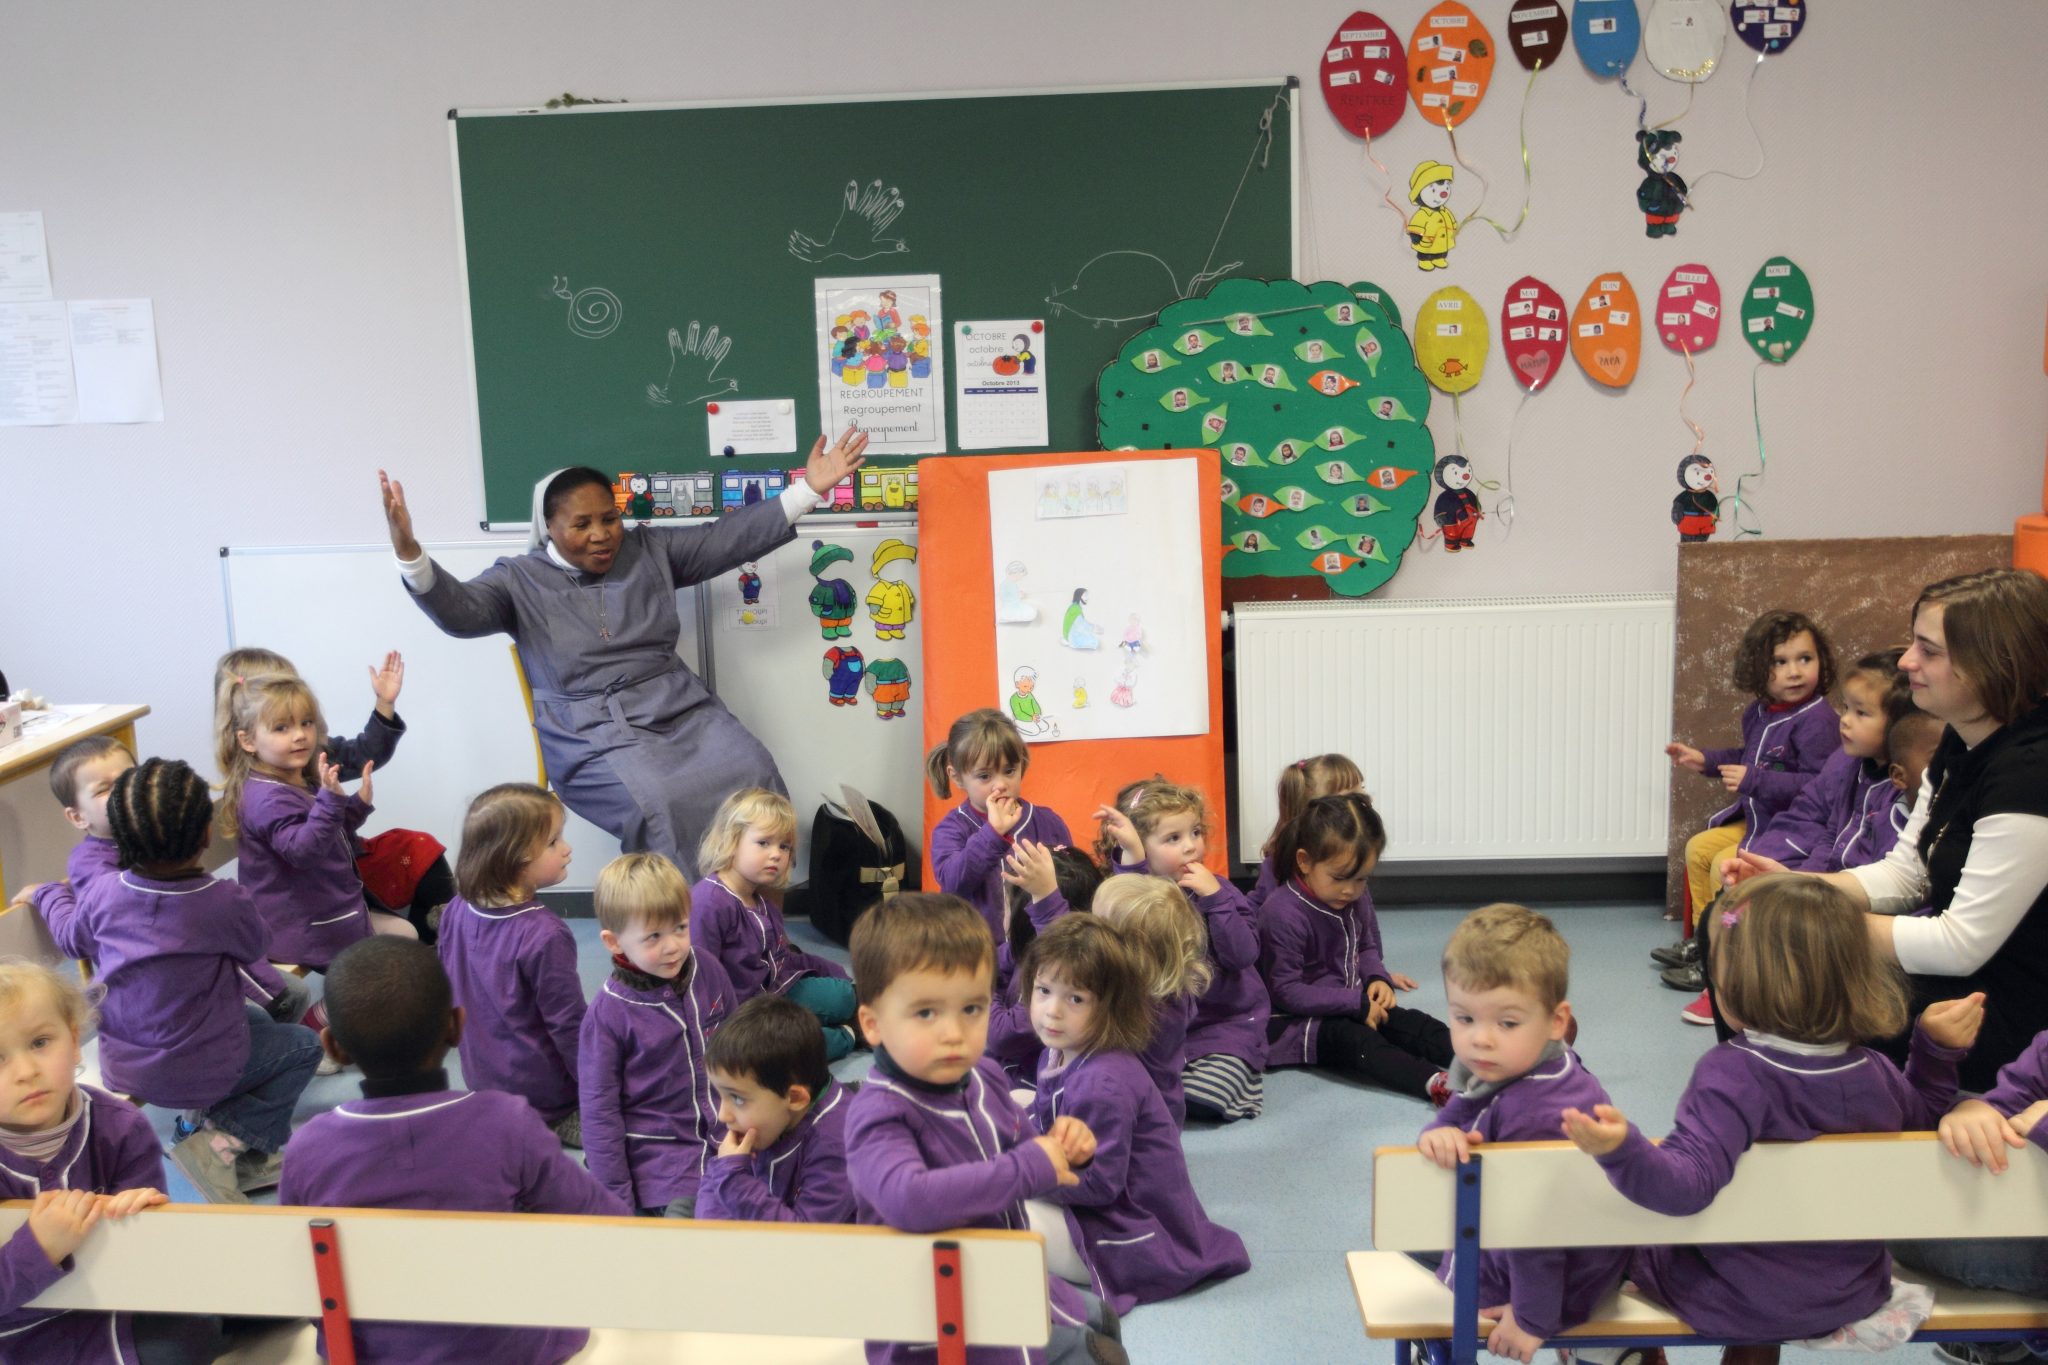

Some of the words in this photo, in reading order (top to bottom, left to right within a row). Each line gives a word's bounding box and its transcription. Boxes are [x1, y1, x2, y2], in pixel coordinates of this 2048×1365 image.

[1521, 289, 1537, 297] MAI
[966, 332, 1007, 341] OCTOBRE
[969, 345, 1004, 354] octobre
[1600, 356, 1620, 366] PAPA
[840, 388, 924, 399] REGROUPEMENT
[843, 403, 922, 417] Regroupement
